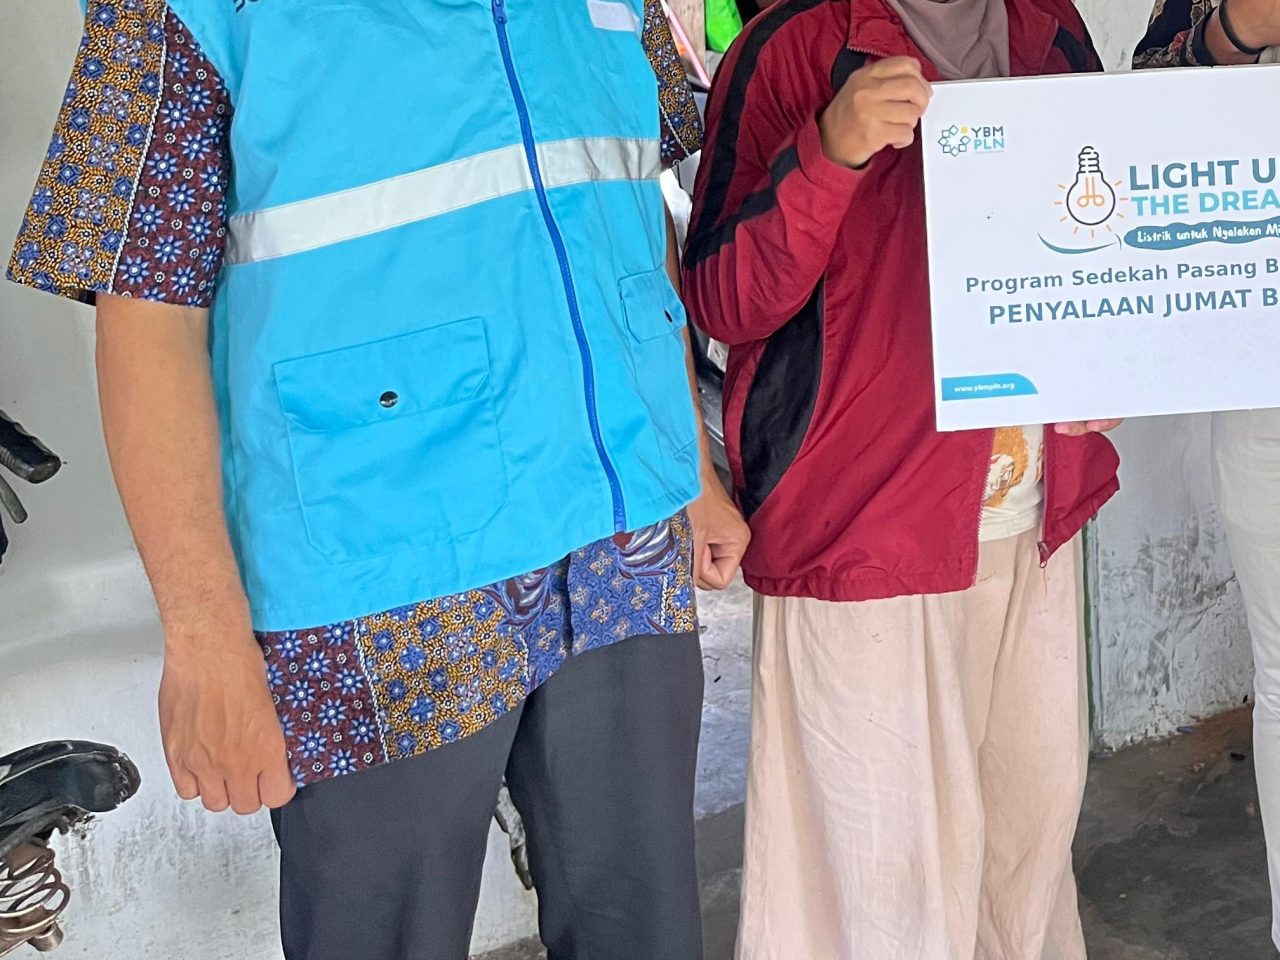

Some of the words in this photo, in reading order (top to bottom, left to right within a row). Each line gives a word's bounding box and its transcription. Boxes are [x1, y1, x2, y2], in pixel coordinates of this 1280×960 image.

[971, 125, 1004, 138] YBM
[973, 138, 1005, 150] PLN
[1129, 159, 1240, 191] LIGHT
[1131, 193, 1189, 217] THE
[1137, 230, 1171, 243] Listrik
[1176, 227, 1209, 241] untuk
[1212, 224, 1262, 240] Nyalakan
[966, 273, 1063, 294] Program
[1072, 265, 1168, 286] Sedekah
[1177, 261, 1257, 279] Pasang
[989, 295, 1154, 325] PENYALAAN
[1163, 288, 1252, 318] JUMAT
